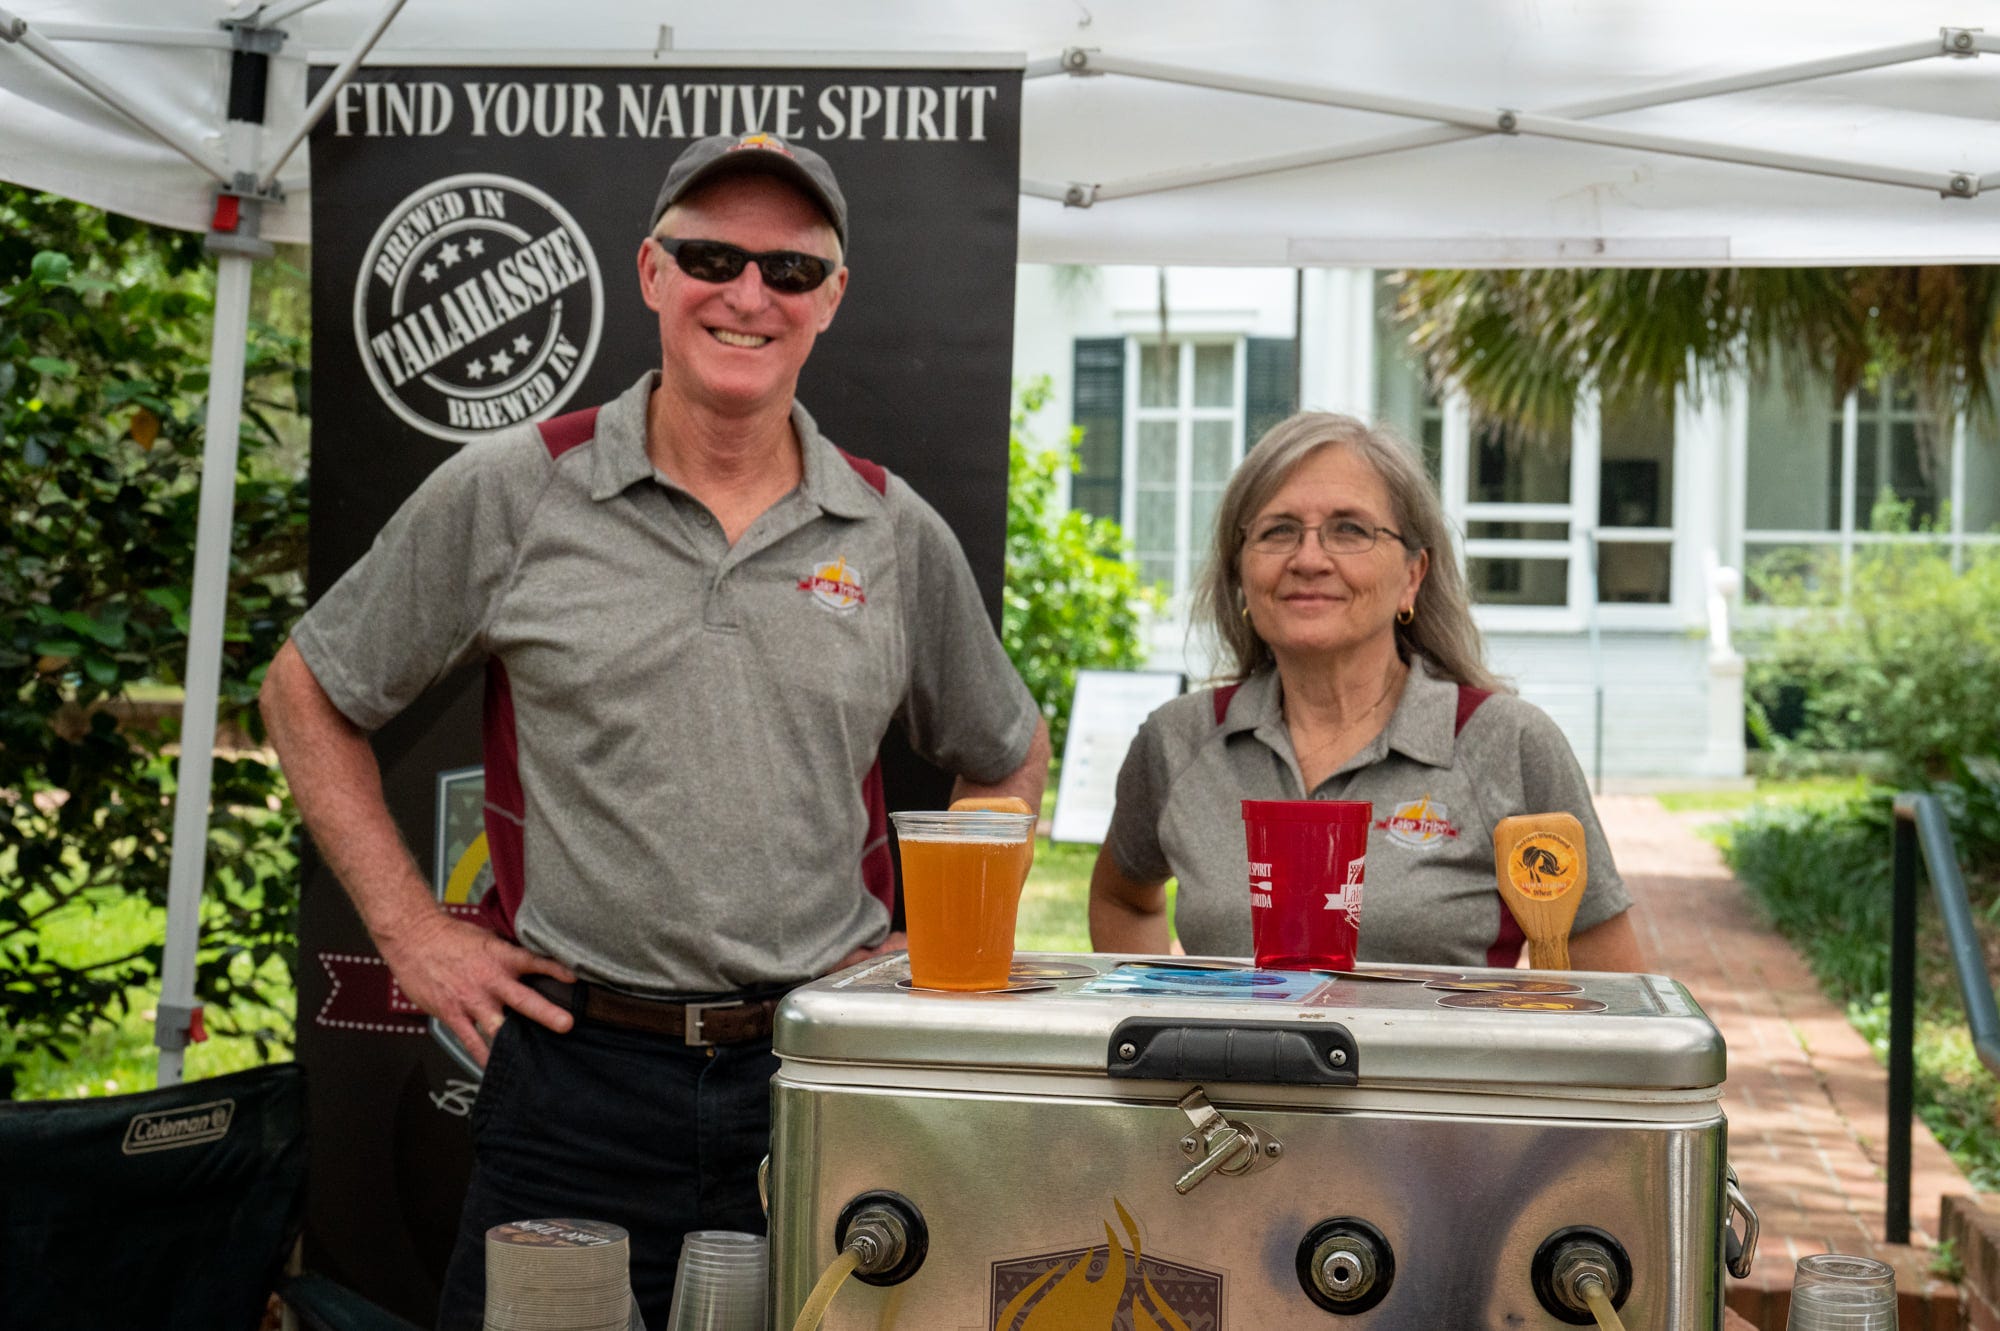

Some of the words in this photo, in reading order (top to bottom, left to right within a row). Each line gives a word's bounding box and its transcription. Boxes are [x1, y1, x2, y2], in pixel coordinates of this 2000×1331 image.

[334, 82, 454, 137] FIND
[462, 82, 607, 138] YOUR
[616, 83, 805, 139] NATIVE
[817, 84, 997, 141] SPIRIT
[374, 191, 465, 288] BREWED
[469, 188, 506, 219] IN
[370, 226, 588, 387] TALLAHASSEE
[447, 370, 556, 429] BREWED
[549, 334, 580, 382] IN
[1389, 817, 1417, 832] Lake
[1419, 820, 1448, 835] Tribe
[1251, 862, 1273, 878] SPIRIT
[134, 1115, 211, 1140] Coleman
